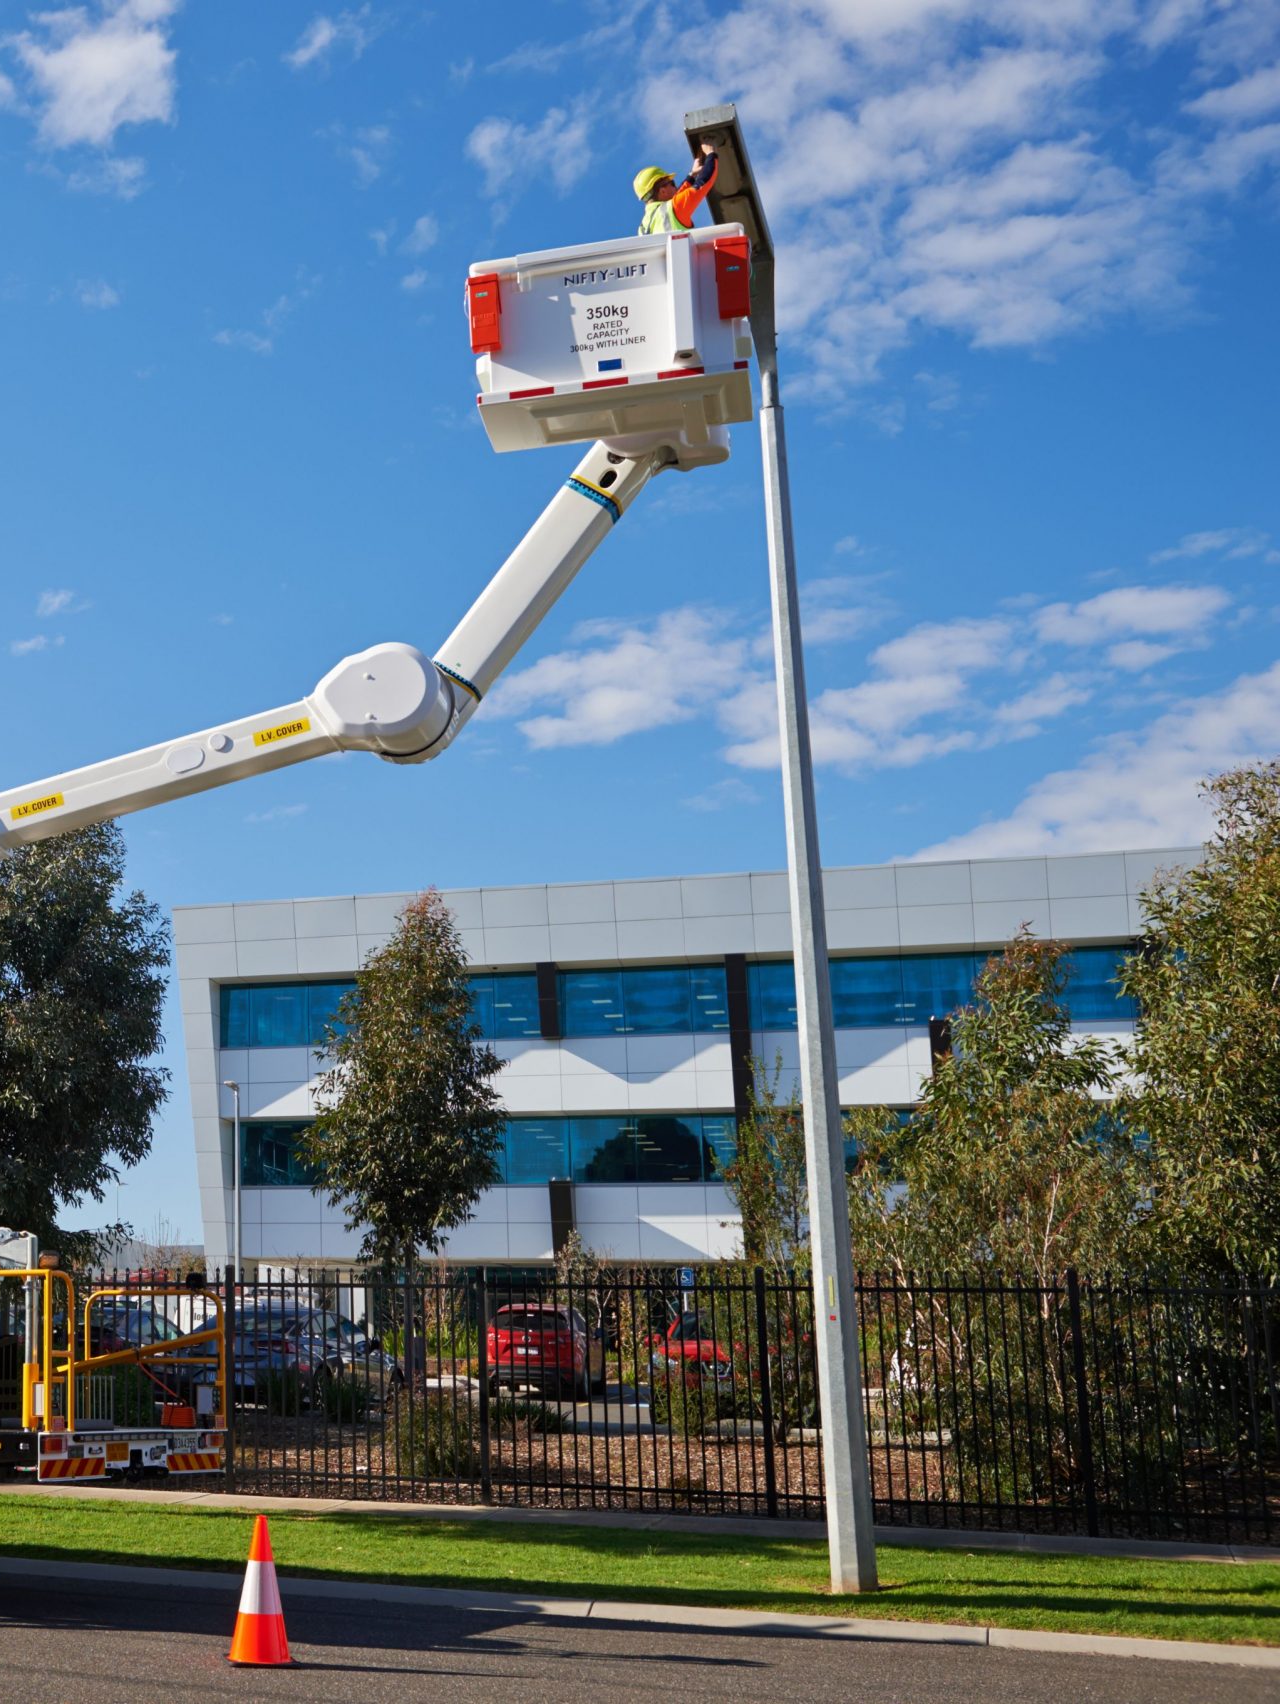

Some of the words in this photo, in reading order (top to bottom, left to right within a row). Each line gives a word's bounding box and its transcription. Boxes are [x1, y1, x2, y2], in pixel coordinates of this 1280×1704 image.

[563, 263, 648, 287] NIFTY-LIFT
[586, 304, 629, 320] 350kg
[592, 320, 623, 331] RATED
[586, 328, 630, 341] CAPACITY
[570, 343, 595, 354] 300kg
[596, 339, 618, 350] WITH
[620, 335, 646, 346] LINER
[261, 731, 276, 742] L.V.
[276, 722, 303, 738] COVER
[32, 796, 57, 811] COVER
